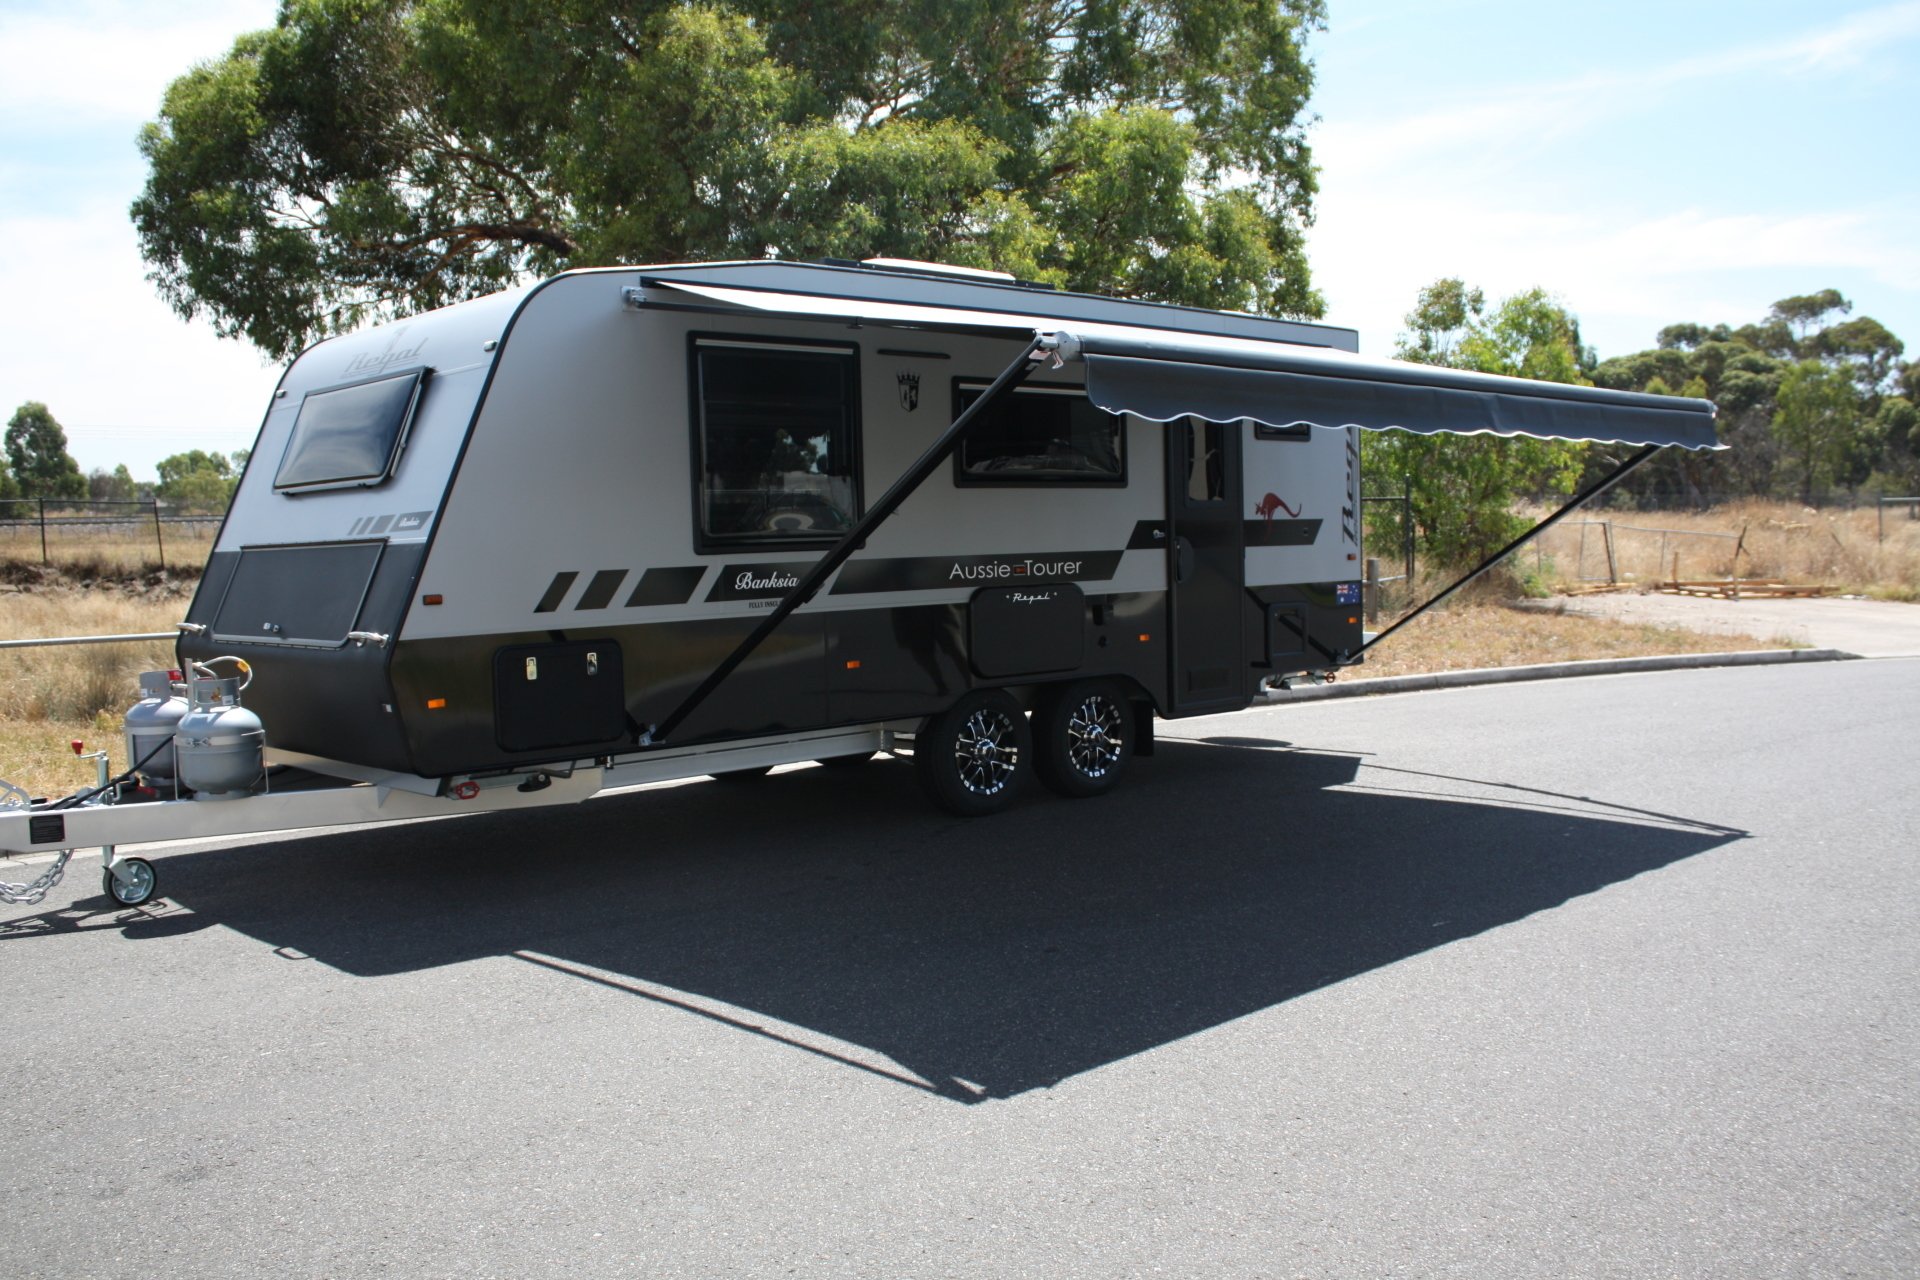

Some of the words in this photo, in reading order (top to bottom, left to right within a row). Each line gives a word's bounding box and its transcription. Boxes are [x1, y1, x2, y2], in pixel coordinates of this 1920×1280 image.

[344, 336, 430, 374] Regal
[949, 561, 1011, 580] Aussie
[1024, 560, 1082, 577] Tourer
[734, 571, 800, 590] Banksia
[1012, 592, 1051, 604] Regal
